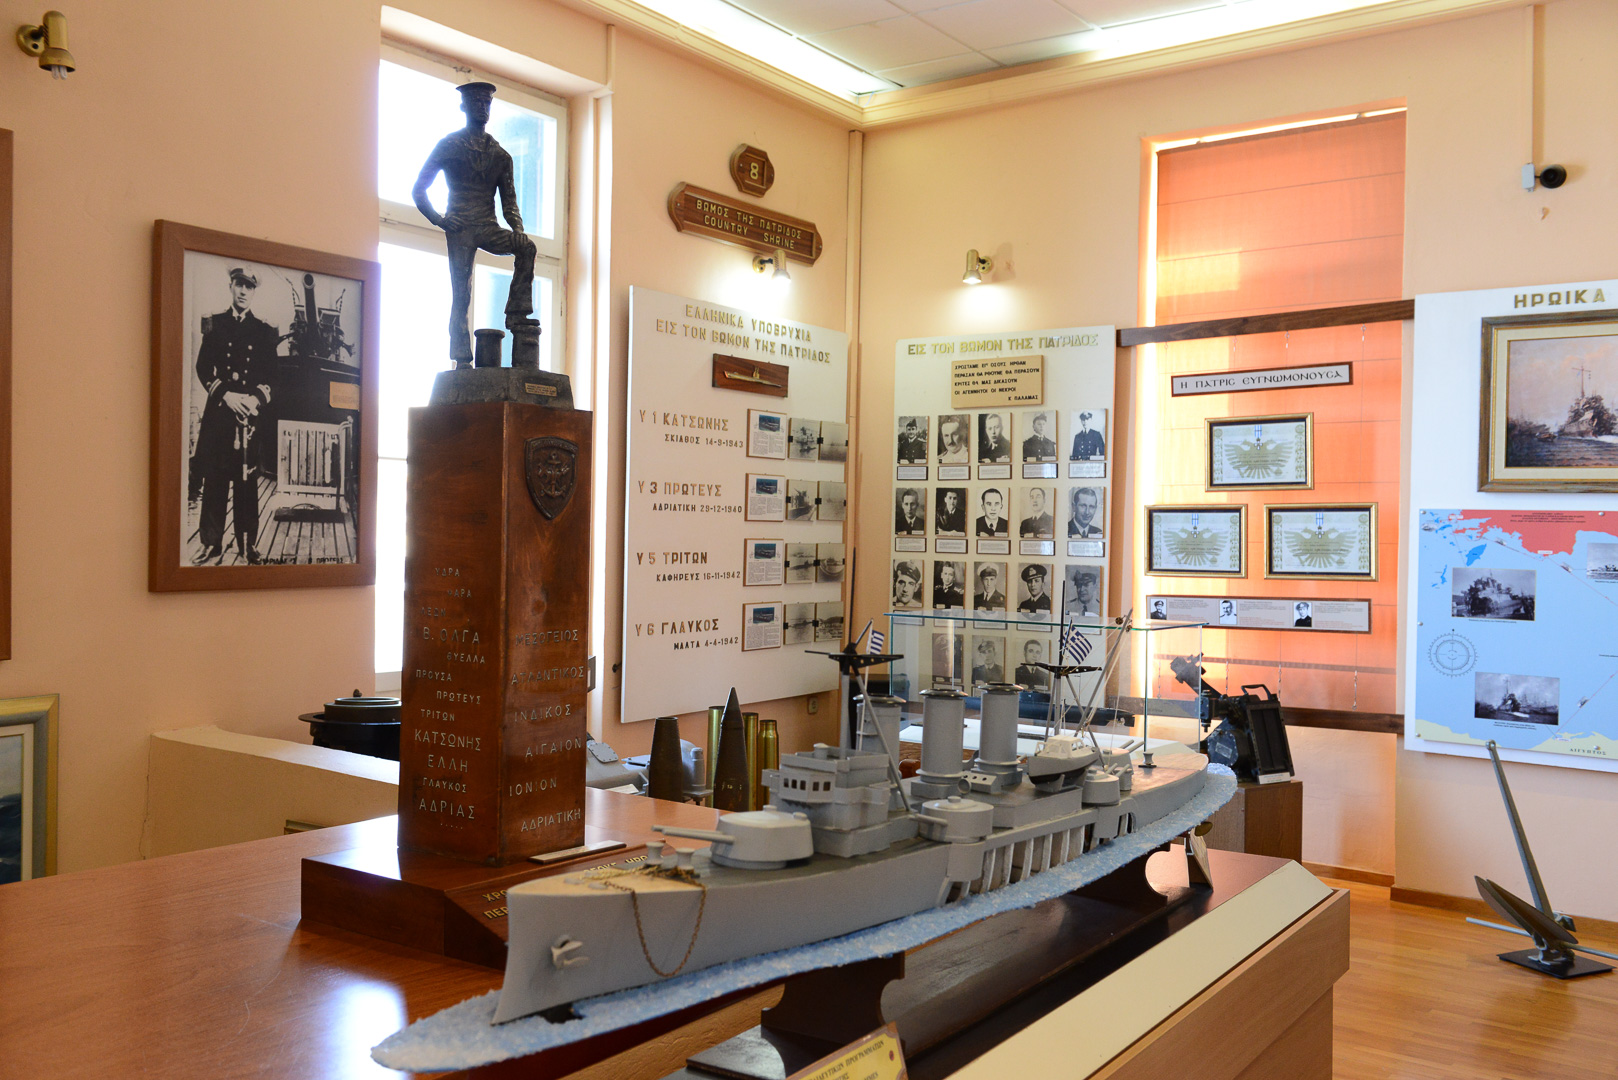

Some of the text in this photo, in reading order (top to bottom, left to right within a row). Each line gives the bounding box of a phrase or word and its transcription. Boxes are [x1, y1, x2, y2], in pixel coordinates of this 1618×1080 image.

[750, 162, 758, 180] 8
[696, 200, 802, 240] ΒΩΜΟΣ ΤΗΣ ΠΑΤΡΙΔΟΣ
[704, 215, 795, 249] COUNTRY SHRINE
[1514, 288, 1606, 309] ΗΡΩΙΚΑ
[685, 304, 812, 342] ΕΛΛΗΝΙΚΑ ΥΠΟΒΡΥΧΙΑ
[656, 318, 831, 364] ΕΙΣ ΤΟΝ ΒΩΜΟΝ ΤΗΣ ΠΑΤΡΙΔΟΣ
[908, 333, 1099, 355] ΕΙΣ ΤΟΝ ΒΩΜΟΝ ΤΗΣ ΠΑΤΡΙΔΟΣ
[1180, 381, 1188, 389] Η
[663, 412, 729, 432] ΚΑΤΣΩΝΗΣ
[664, 433, 701, 445] ΣΚΙΑΘΟΣ
[705, 437, 744, 449] 14-9-1943
[650, 481, 658, 494] 3
[664, 482, 722, 497] ΠΡΩΤΕΥΣ
[652, 503, 696, 513] ΑΔΡΙΑΤΙΚΗ
[700, 504, 742, 513] 29-12-1940
[648, 552, 656, 565] 5
[662, 551, 708, 565] ΤΡΙΤΩΝ
[656, 572, 700, 582] ΚΑΦΗΡΕΥΣ
[703, 571, 741, 580] 16-11-1942
[440, 628, 480, 644] ΟΛΓΑ
[647, 623, 654, 636] 6
[661, 618, 719, 635] ΓΛΑΥΚΟΣ
[515, 629, 579, 646] ΜΕΣΟΓΕΙΟΣ
[674, 640, 700, 650] ΜΑΛΤΑ
[704, 636, 739, 648] 4-4-1942
[446, 651, 486, 664] ΘΥΕΛΛΑ
[415, 669, 452, 681] ΠΡΟΥΣΑ
[511, 666, 585, 685] ΑΤΛΑΝΤΙΚΟΣ
[436, 690, 481, 704] ΠΡΩΤΕΥΣ
[420, 708, 455, 722] ΤΡΙΤΩΝ
[514, 704, 571, 722] ΙΝΔΙΚΟΣ
[414, 728, 481, 752] ΚΑΤΣΩΝΗΣ
[525, 737, 582, 758] ΑΙΓΑΙΟΝ
[427, 754, 469, 773] ΕΛΛΗ
[422, 777, 467, 793] ΓΛΑΥΚΟΣ
[509, 777, 557, 797] ΙΟΝΙΟΝ
[418, 797, 475, 820] ΑΔΡΙΑΣ
[520, 808, 581, 832] ΑΔΡΙΑΤΙΚΗ
